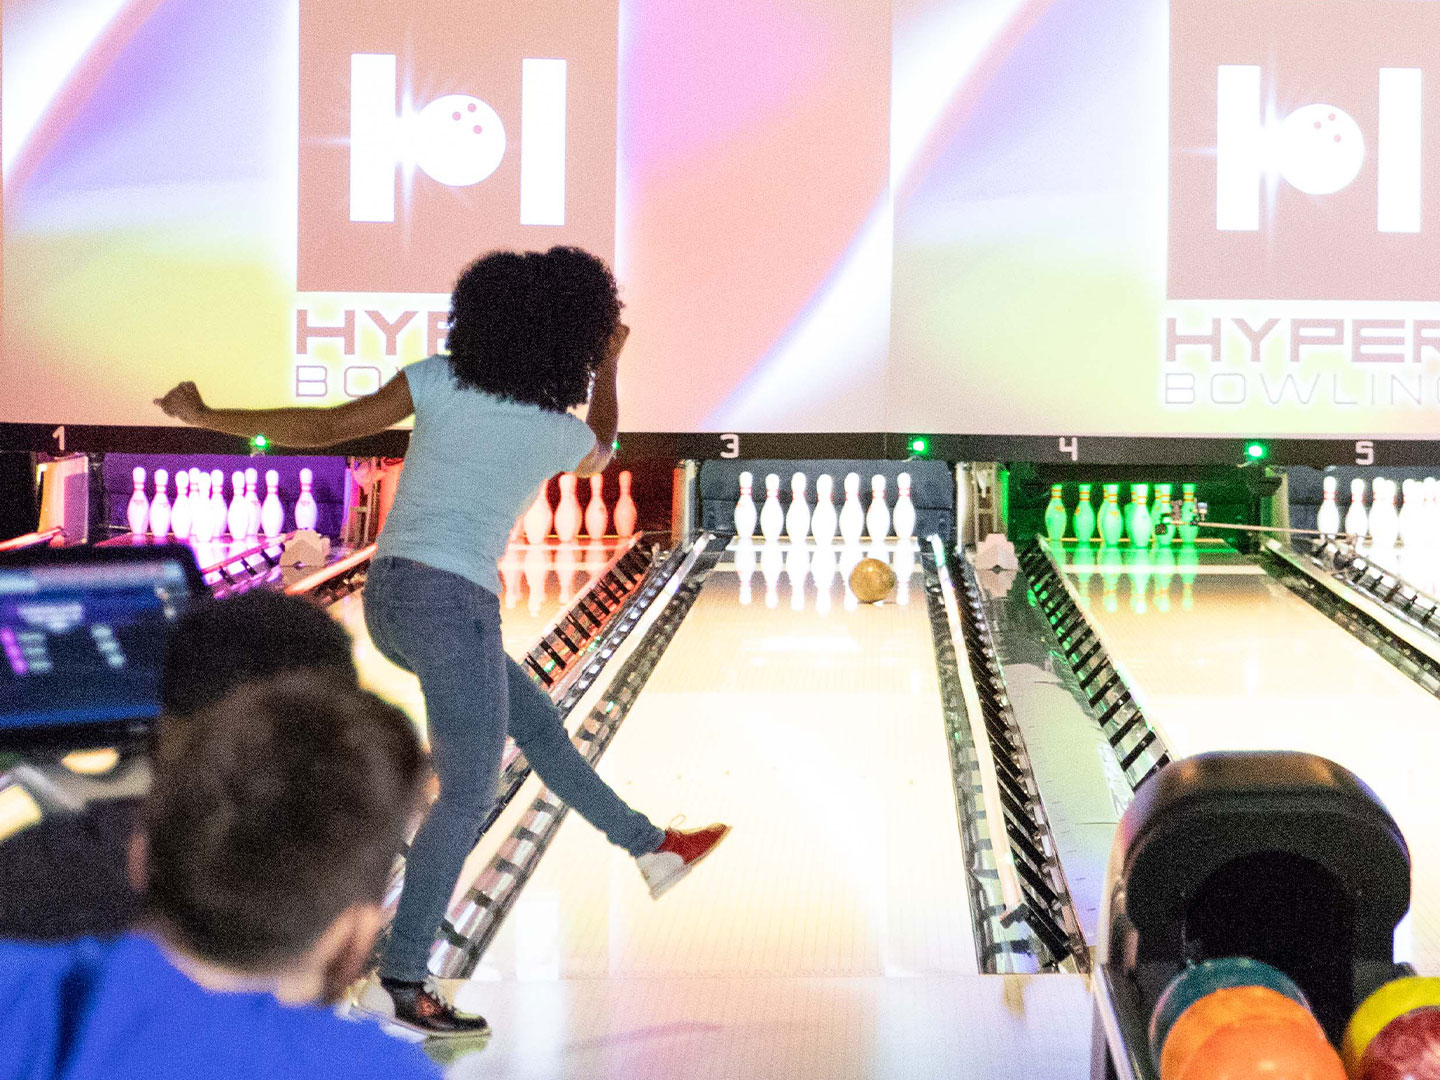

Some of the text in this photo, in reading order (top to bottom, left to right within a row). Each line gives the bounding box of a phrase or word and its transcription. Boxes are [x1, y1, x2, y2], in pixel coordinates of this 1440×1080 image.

[296, 309, 449, 356] HYP
[52, 425, 65, 451] 1
[720, 433, 740, 459] 3
[1059, 436, 1079, 462] 4
[1355, 440, 1375, 466] 5
